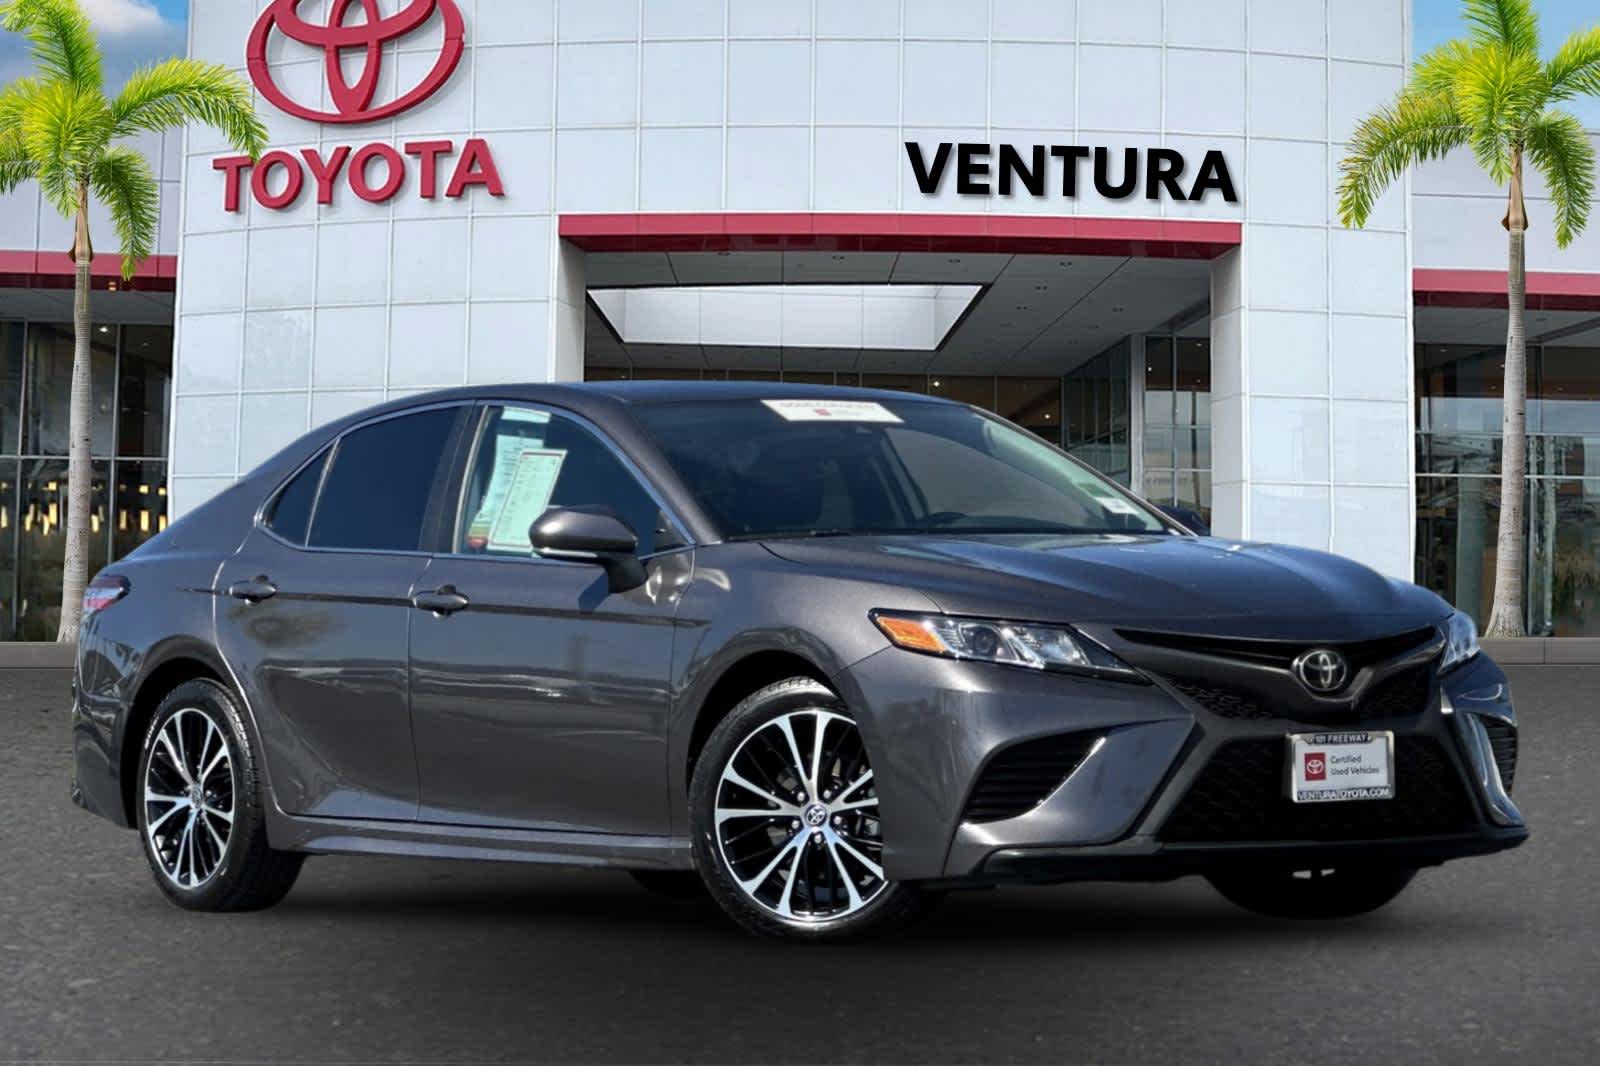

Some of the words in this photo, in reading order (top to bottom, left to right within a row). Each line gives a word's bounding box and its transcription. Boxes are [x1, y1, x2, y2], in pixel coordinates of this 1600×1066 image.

[213, 138, 505, 212] TOYOTA
[905, 142, 1238, 202] VENTURA
[1328, 734, 1367, 743] FREEWAY
[1330, 754, 1362, 764] Certified
[1330, 767, 1349, 776] Used
[1350, 765, 1379, 775] Vehicles
